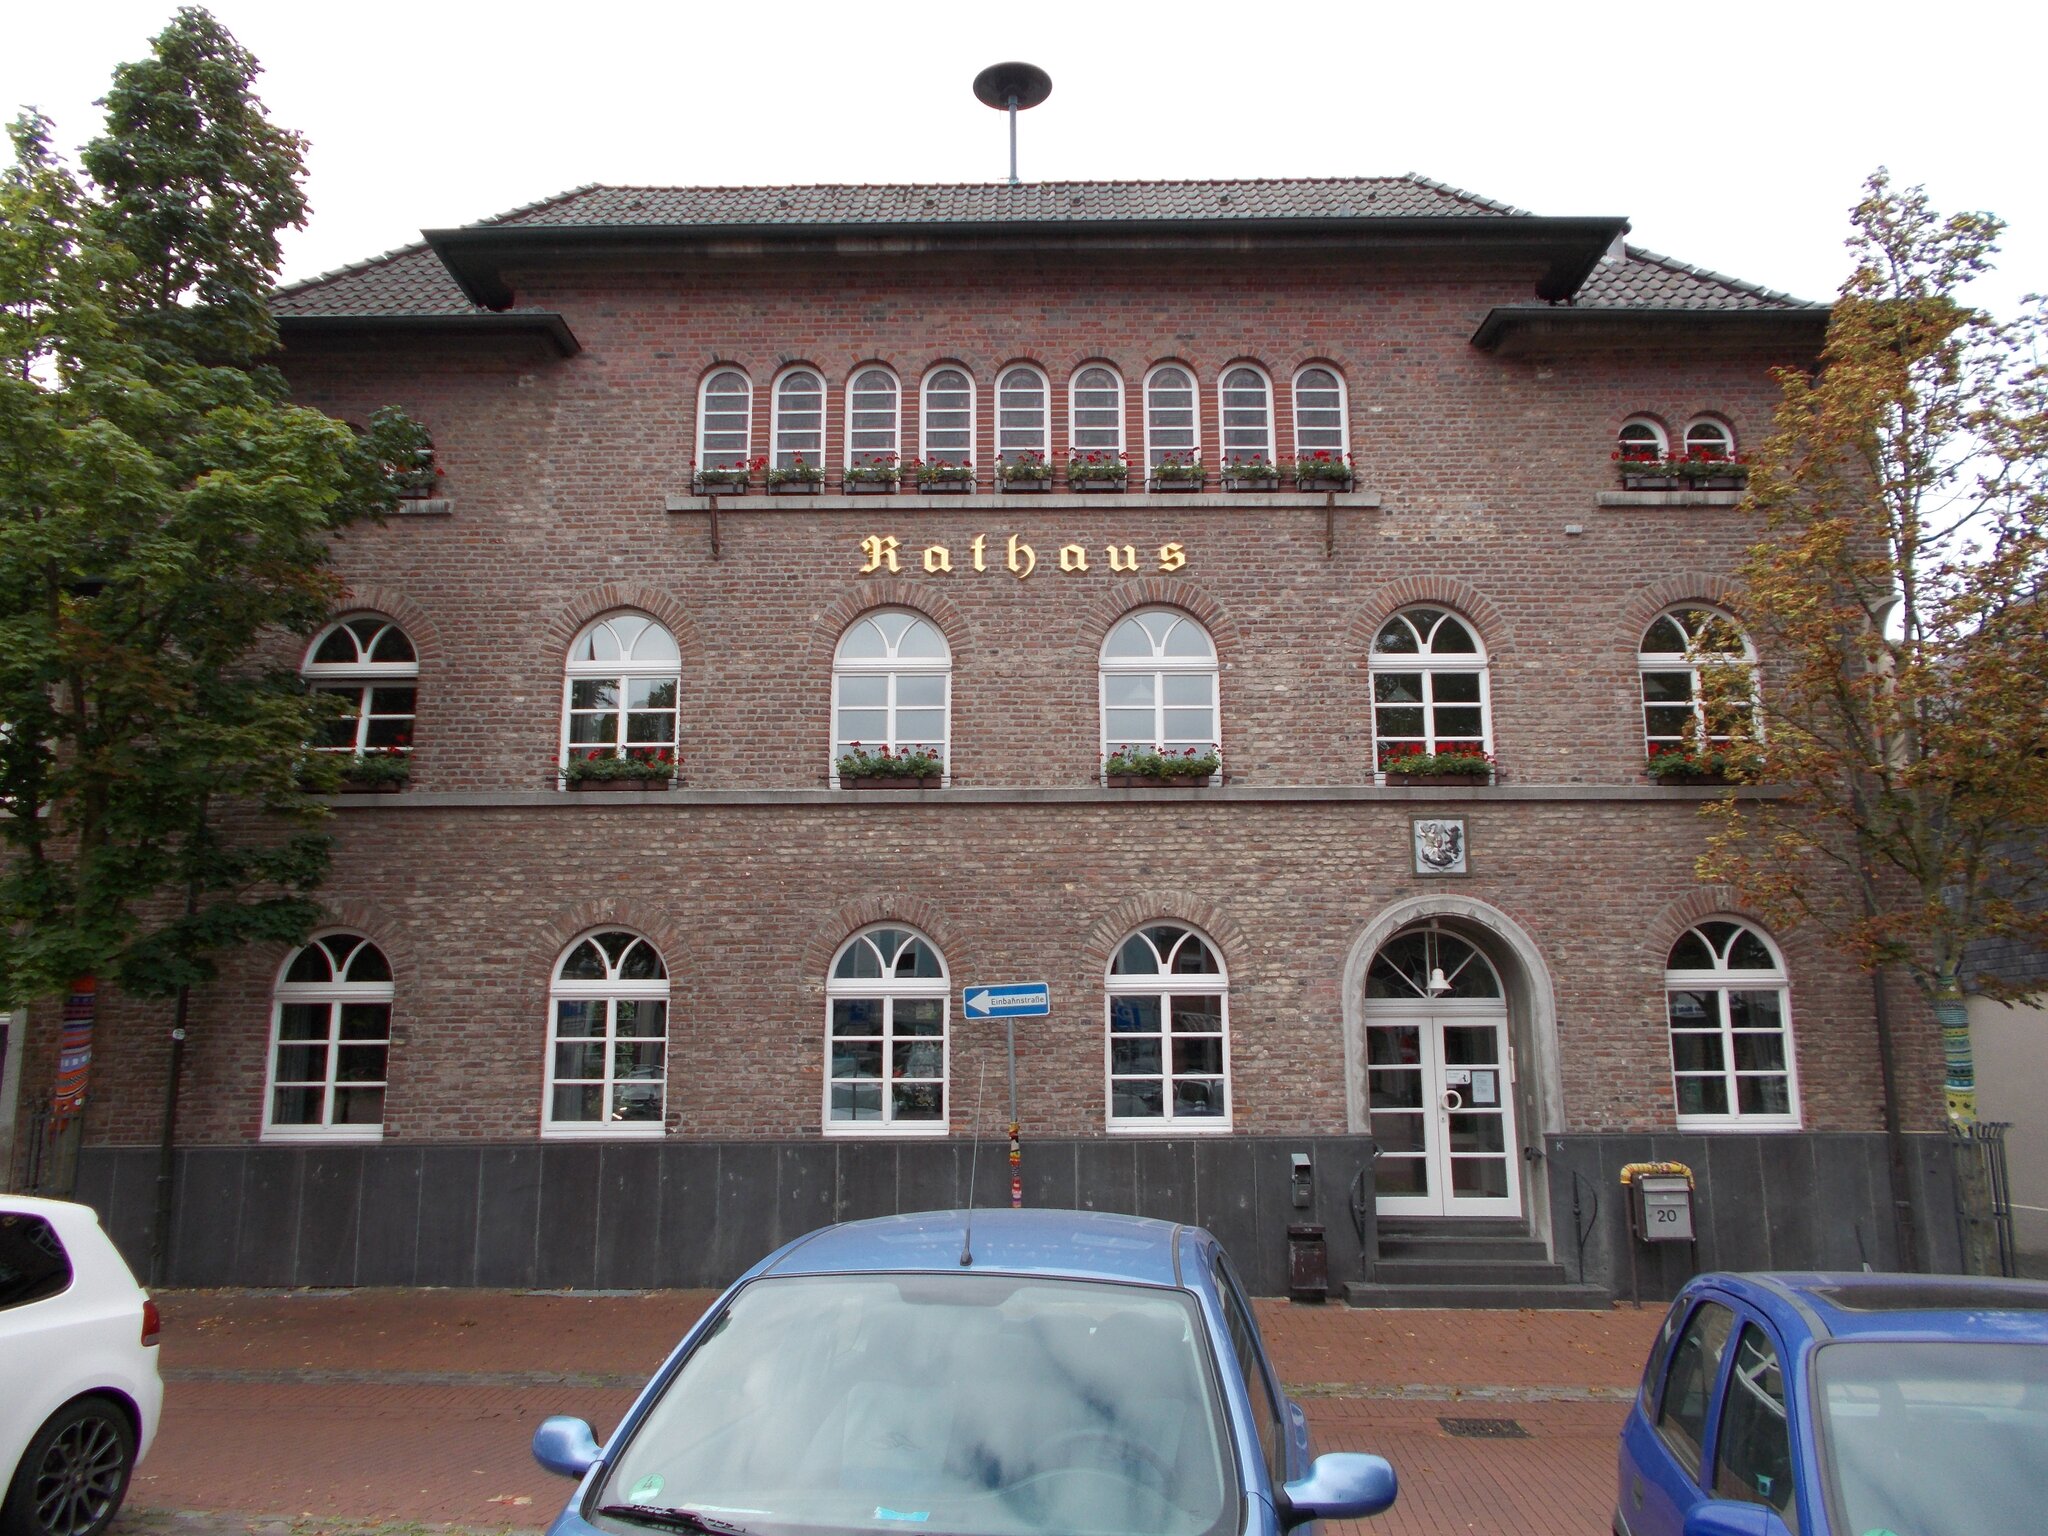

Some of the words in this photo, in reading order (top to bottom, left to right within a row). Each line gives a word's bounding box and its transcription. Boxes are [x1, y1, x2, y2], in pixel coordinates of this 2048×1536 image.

[859, 533, 1188, 579] Rathaus
[991, 995, 1045, 1006] Einbahnstraße
[1657, 1209, 1677, 1222] 20
